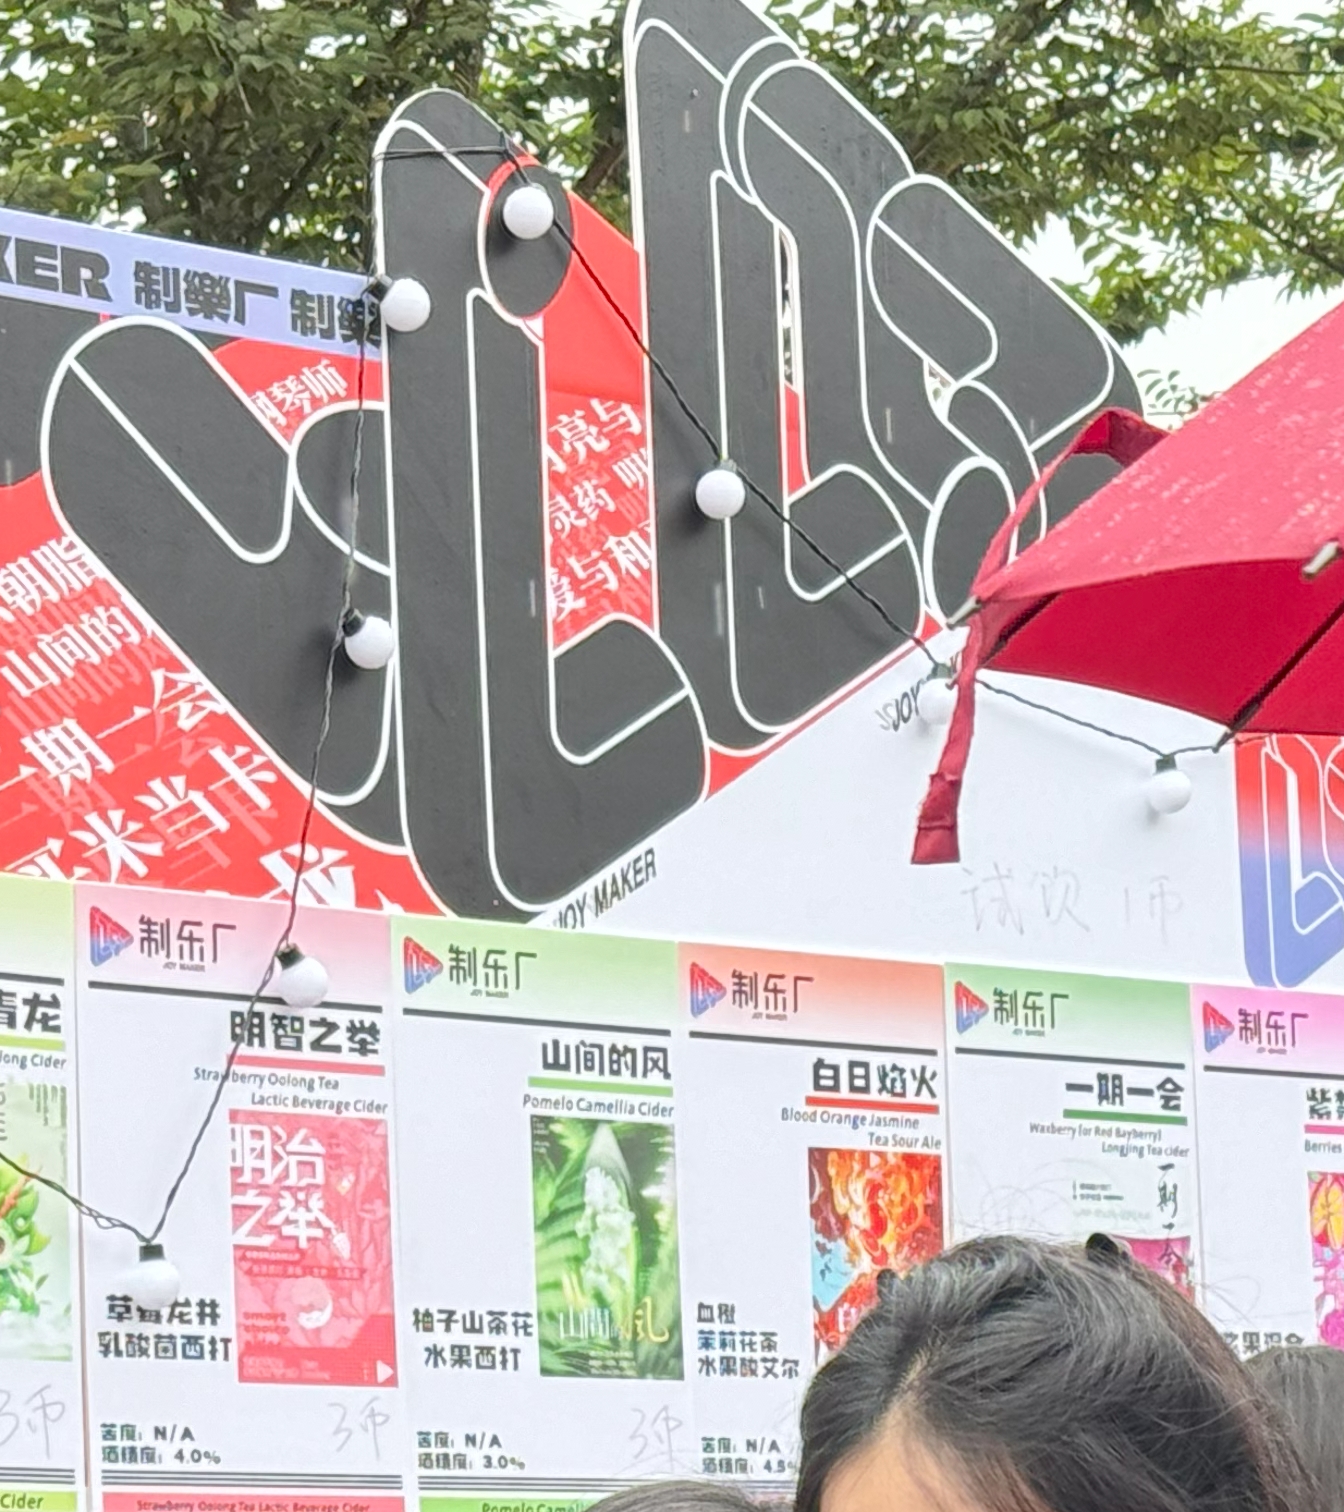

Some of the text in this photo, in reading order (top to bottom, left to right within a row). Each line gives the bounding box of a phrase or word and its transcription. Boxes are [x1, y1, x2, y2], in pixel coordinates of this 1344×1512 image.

[133, 260, 279, 326] 制樂厂
[546, 398, 642, 473] 亮与
[0, 600, 153, 697] 山间的
[594, 848, 656, 918] MAKER
[138, 914, 236, 963] 制乐厂
[448, 943, 537, 990] 制乐厂
[731, 969, 814, 1012] 制乐厂
[993, 987, 1069, 1029] 制乐厂
[230, 1011, 380, 1056] 明智之举
[1238, 1008, 1309, 1048] 制乐厂
[31, 1052, 66, 1070] Cider
[541, 1039, 672, 1080] 山间的风
[268, 1073, 315, 1092] Oolong
[318, 1076, 339, 1090] Tea
[813, 1057, 938, 1099] 白日焰火
[1065, 1072, 1184, 1111] 一期一会
[251, 1092, 387, 1114] Lactic Beverage Cider
[523, 1094, 674, 1117] Pomelo Camellia Cider
[781, 1107, 919, 1130] Blood Orange Jasmine
[868, 1132, 942, 1149] Tea Sour Ale
[413, 1307, 533, 1337] 柚子山茶花
[424, 1343, 521, 1372] 水果西打
[154, 1425, 195, 1442] N/A
[465, 1432, 502, 1449] N/A
[746, 1437, 781, 1454] N/A
[174, 1448, 221, 1465] 4.0%
[483, 1455, 525, 1470] 3.0%
[0, 1493, 44, 1510] Cider
[238, 1502, 256, 1512] Tea
